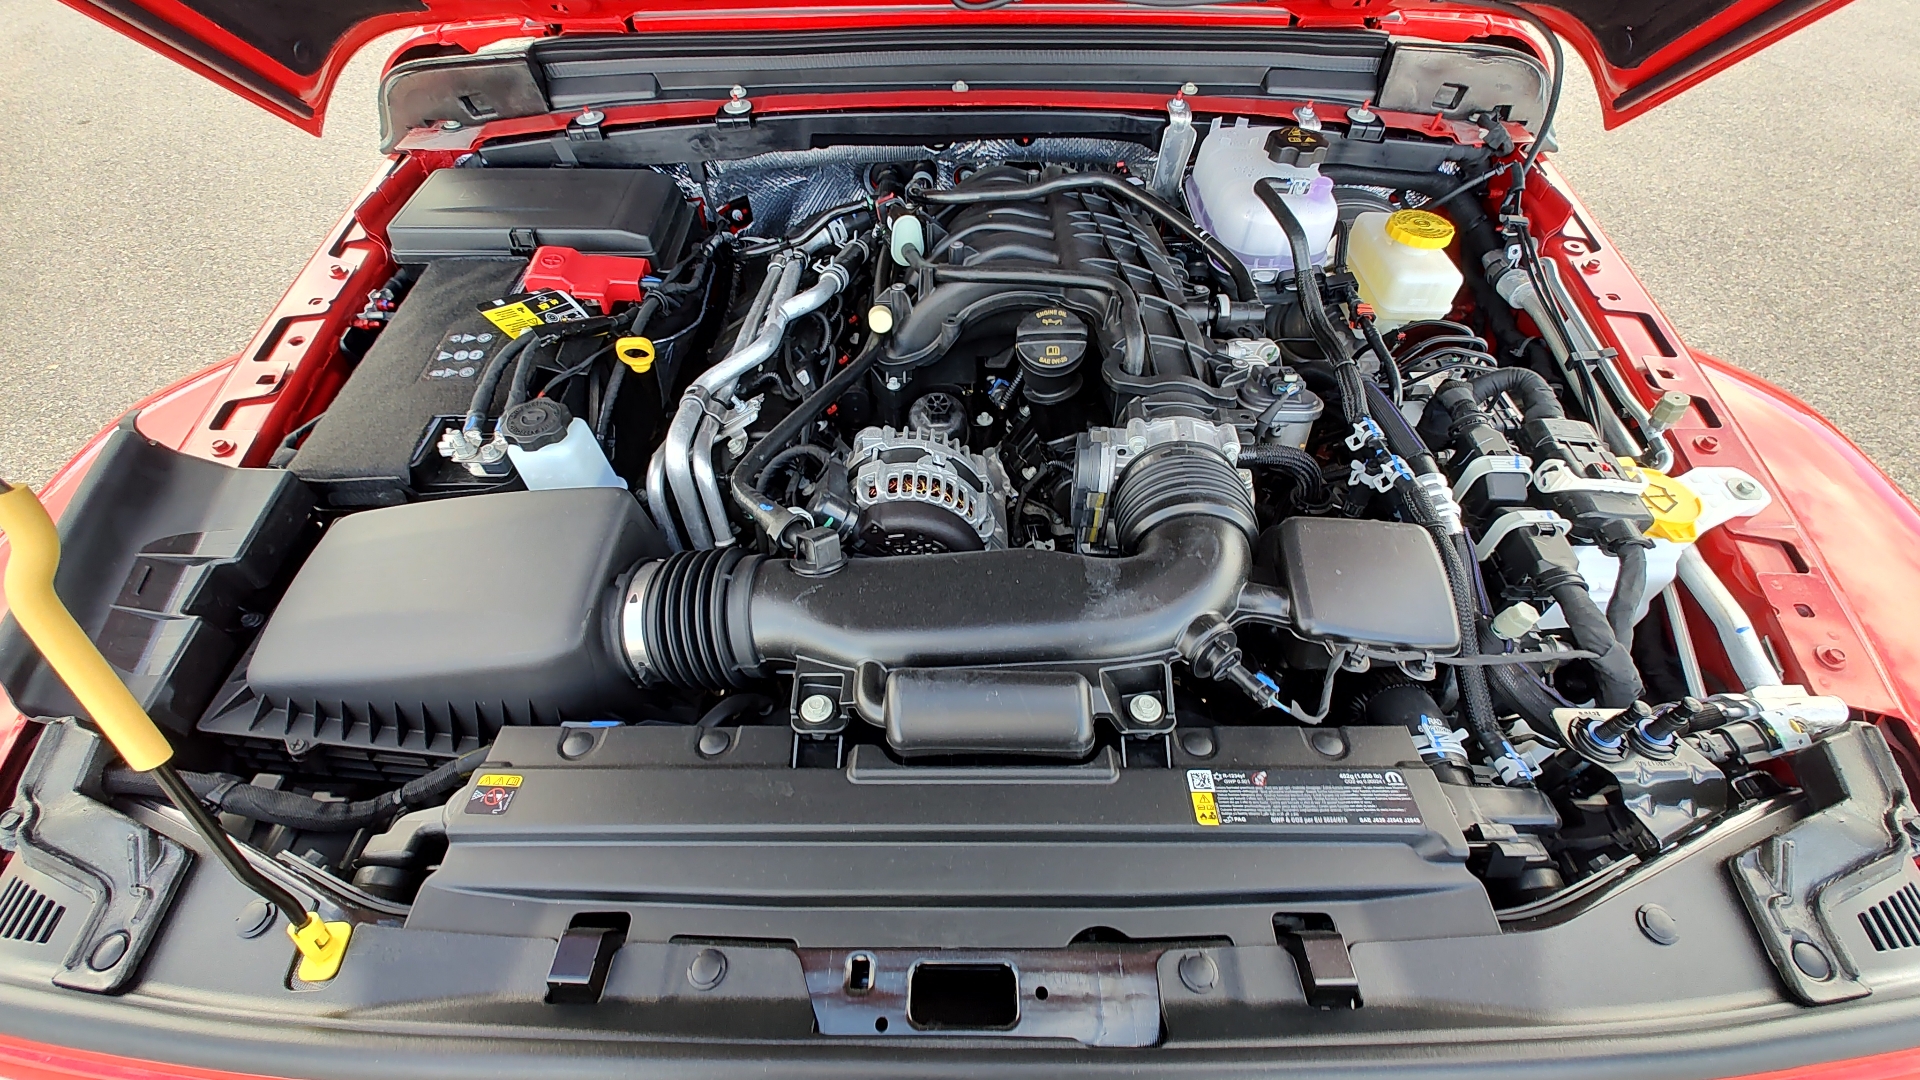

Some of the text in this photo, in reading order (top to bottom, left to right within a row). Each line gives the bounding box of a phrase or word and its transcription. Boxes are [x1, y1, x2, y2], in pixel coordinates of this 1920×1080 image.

[1036, 309, 1067, 318] ENGINE OIL
[1039, 356, 1051, 364] SAE
[1427, 717, 1443, 726] RAD
